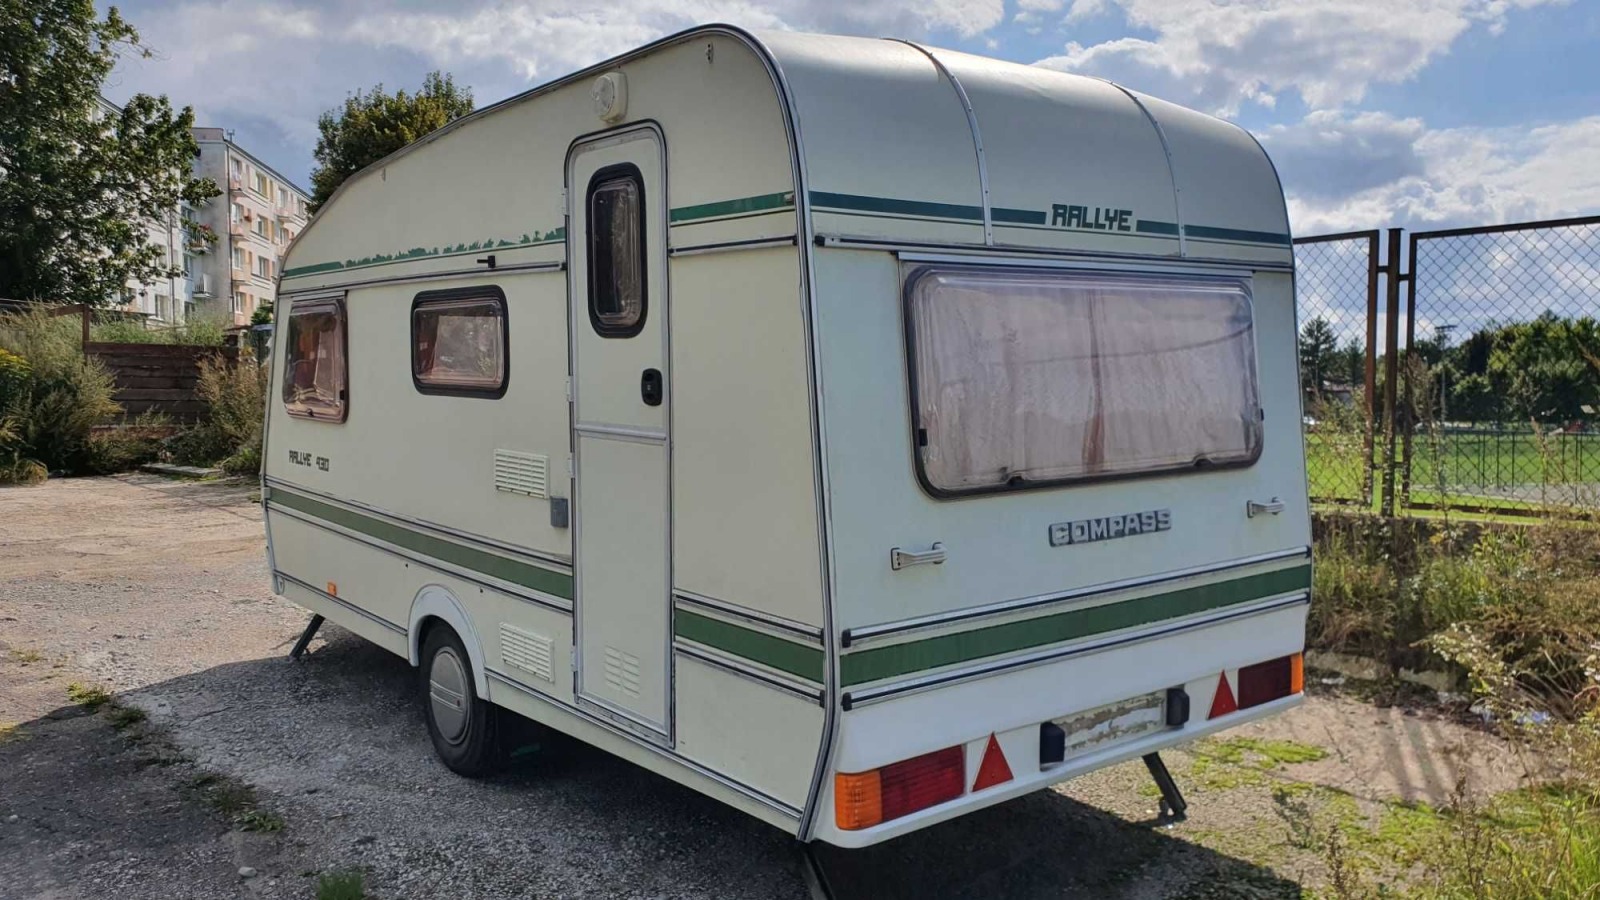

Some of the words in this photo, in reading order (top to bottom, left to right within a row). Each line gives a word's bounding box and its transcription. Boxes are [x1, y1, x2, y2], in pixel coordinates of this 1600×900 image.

[1052, 203, 1133, 232] RALLYE
[289, 450, 312, 467] RALLYE
[316, 456, 330, 472] 430
[1049, 508, 1171, 547] COMPASS
